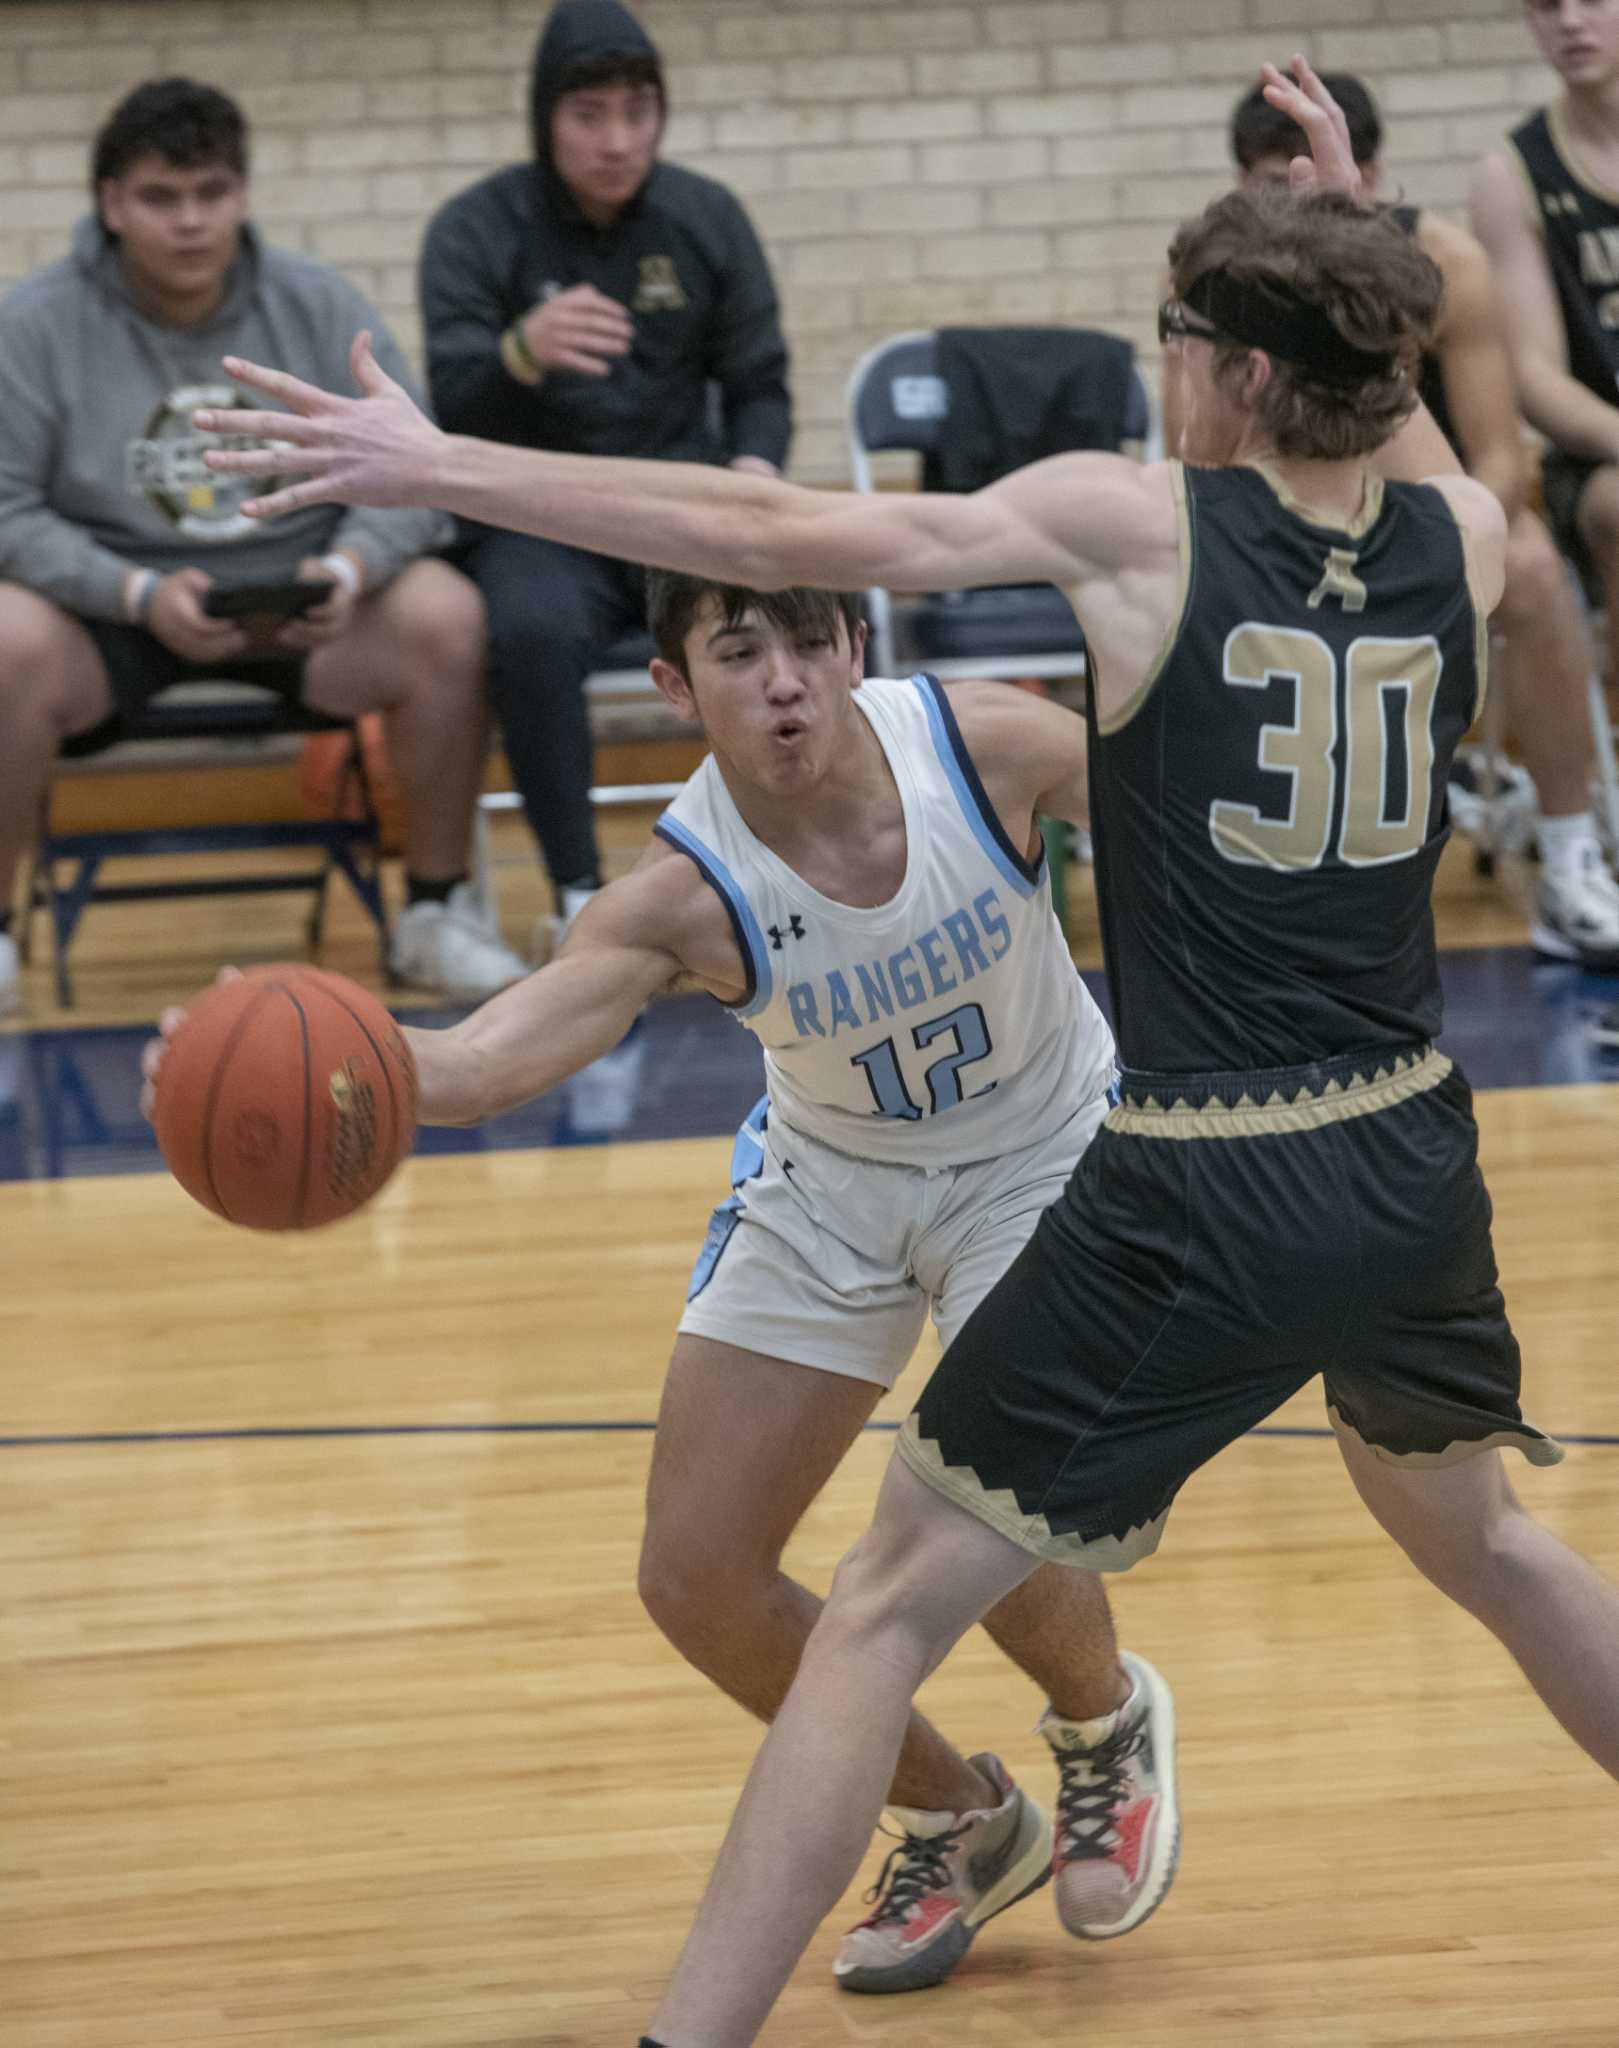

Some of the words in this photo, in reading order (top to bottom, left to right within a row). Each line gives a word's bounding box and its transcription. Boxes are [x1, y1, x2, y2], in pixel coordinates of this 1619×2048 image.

[1209, 621, 1443, 872] 30
[787, 887, 1012, 1038] RANGERS
[851, 1003, 997, 1121] 12
